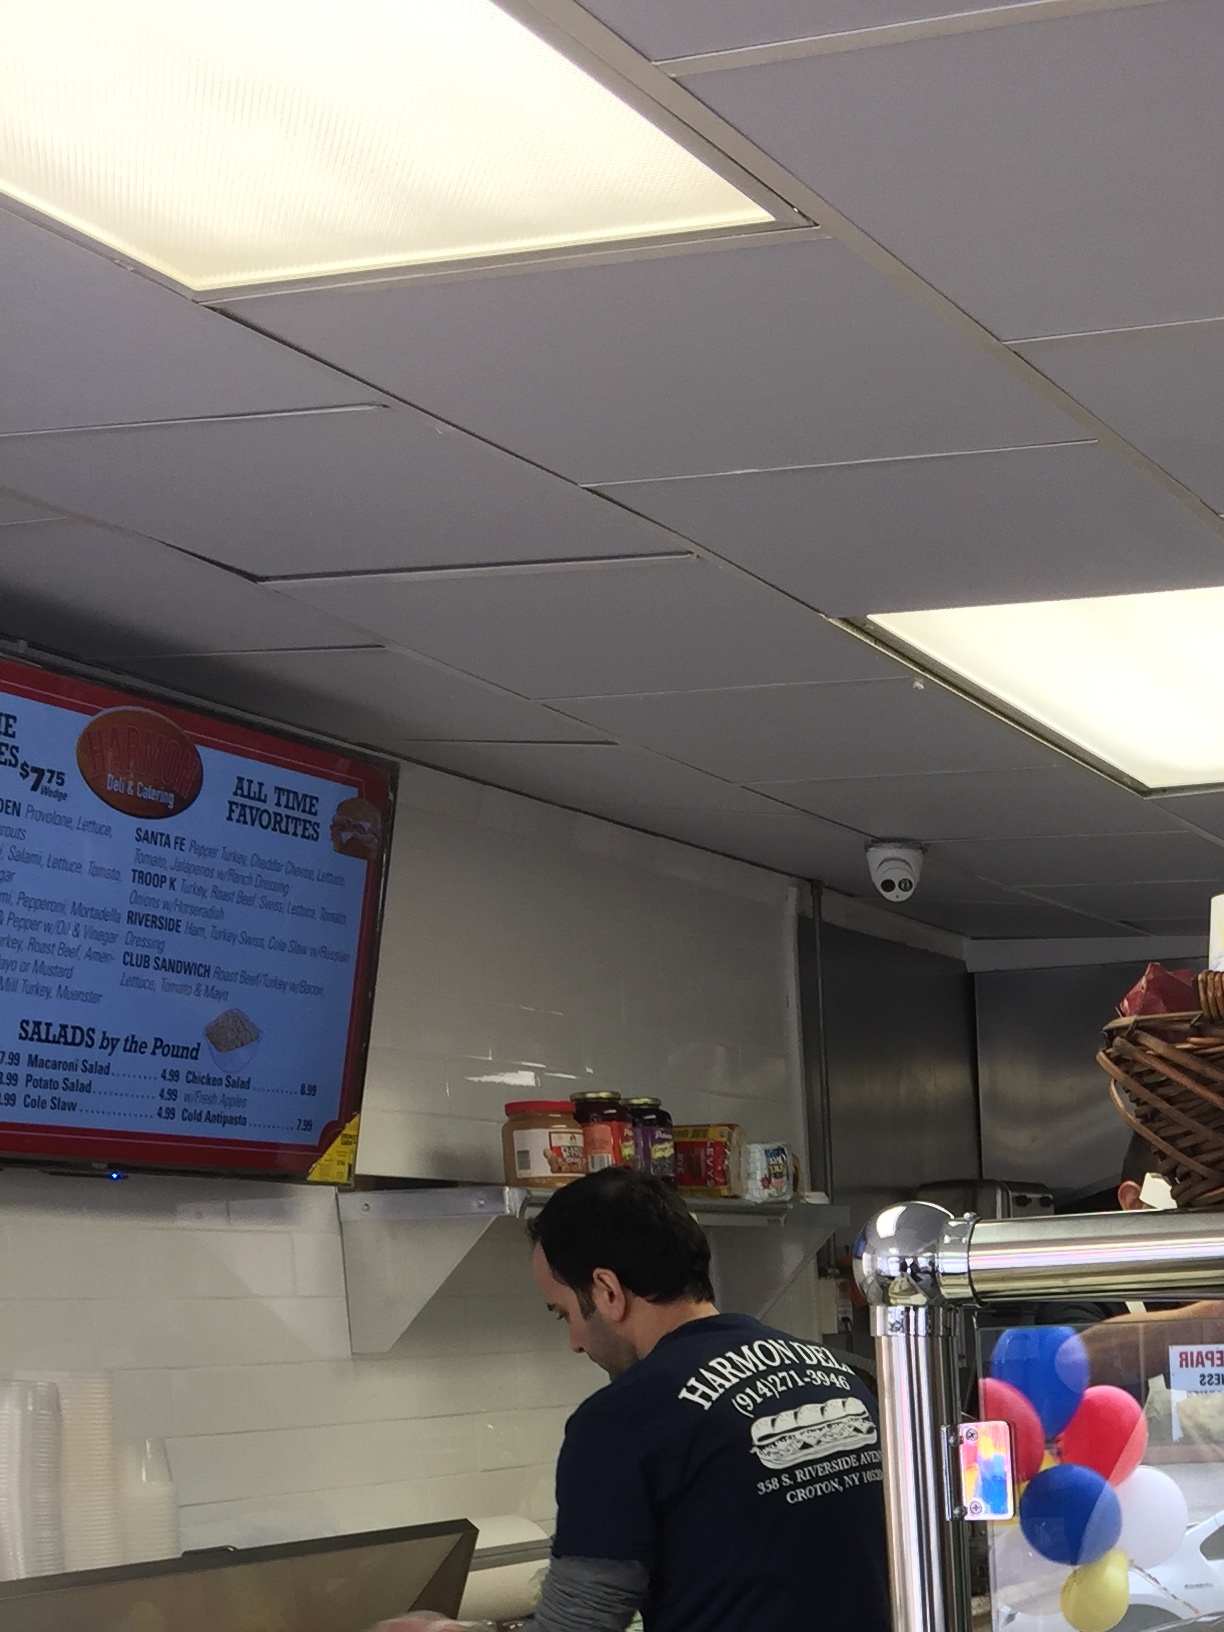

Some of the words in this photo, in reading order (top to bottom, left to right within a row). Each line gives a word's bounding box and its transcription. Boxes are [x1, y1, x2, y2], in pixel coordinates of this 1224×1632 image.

[87, 725, 200, 799] HARMON
[40, 784, 68, 803] Wedge
[106, 773, 125, 794] Deli
[127, 780, 134, 796] &
[136, 781, 175, 809] Catering
[233, 776, 268, 805] ALL
[274, 785, 319, 817] TIME
[25, 804, 73, 830] Provolone,
[76, 815, 113, 838] Lettuce,
[226, 800, 320, 842] FAVORITES
[135, 827, 171, 849] SANTA
[174, 836, 186, 852] FE
[189, 841, 219, 861] Pepper
[8, 845, 44, 868] Salami,
[46, 853, 83, 875] Lettuce,
[88, 861, 123, 882] Tomato,
[131, 869, 168, 889] TROOP
[169, 877, 177, 892] K
[211, 885, 234, 903] Roast
[255, 875, 289, 898] Dressing
[16, 891, 67, 916] Pepperoni,
[71, 901, 122, 924] Mortadella
[129, 890, 161, 910] Onions
[162, 898, 225, 921] w/Horseradish
[6, 911, 42, 932] Pepper
[72, 923, 80, 939] &
[83, 924, 120, 947] Vinegar
[27, 936, 56, 956] Roast
[124, 930, 166, 954] Dressing
[126, 910, 182, 934] RIVERSIDE
[185, 920, 207, 940] Ham,
[268, 936, 287, 953] Cole
[289, 940, 308, 957] Slaw
[19, 960, 31, 973] or
[32, 959, 74, 980] Mustard
[122, 950, 150, 970] CLUB
[153, 955, 211, 980] SANDWICH
[213, 966, 239, 985] Roast
[21, 978, 53, 1001] Turkey,
[56, 984, 103, 1004] Muenster
[119, 971, 157, 993] Lettuce,
[160, 976, 193, 996] Tomato
[193, 982, 201, 997] &
[203, 983, 229, 1003] Mayo
[18, 1018, 96, 1049] SALADS
[99, 1031, 121, 1057] by
[123, 1034, 148, 1056] the
[150, 1036, 201, 1061] Pound
[25, 1073, 59, 1091] Potato
[61, 1076, 92, 1094] Salad
[158, 1088, 178, 1102] 4.99
[184, 1090, 217, 1104] w/Fresh
[219, 1093, 248, 1110] Apples
[27, 1053, 79, 1073] Macaroni
[81, 1058, 111, 1076] Salad
[160, 1068, 180, 1083] 4.99
[185, 1070, 223, 1087] Chicken
[225, 1074, 251, 1090] Salad
[299, 1082, 317, 1097] 8.99
[23, 1094, 48, 1110] Cole
[50, 1096, 77, 1112] Slaw
[157, 1106, 176, 1121] 4.99
[181, 1107, 203, 1122] Cold
[204, 1111, 248, 1128] Antipasto
[296, 1118, 313, 1132] 7.99
[678, 1339, 800, 1411] HARMON
[756, 1477, 780, 1496] 358
[780, 1473, 794, 1487] S.
[795, 1454, 859, 1483] RIVERSIDE
[843, 1472, 861, 1488] NY
